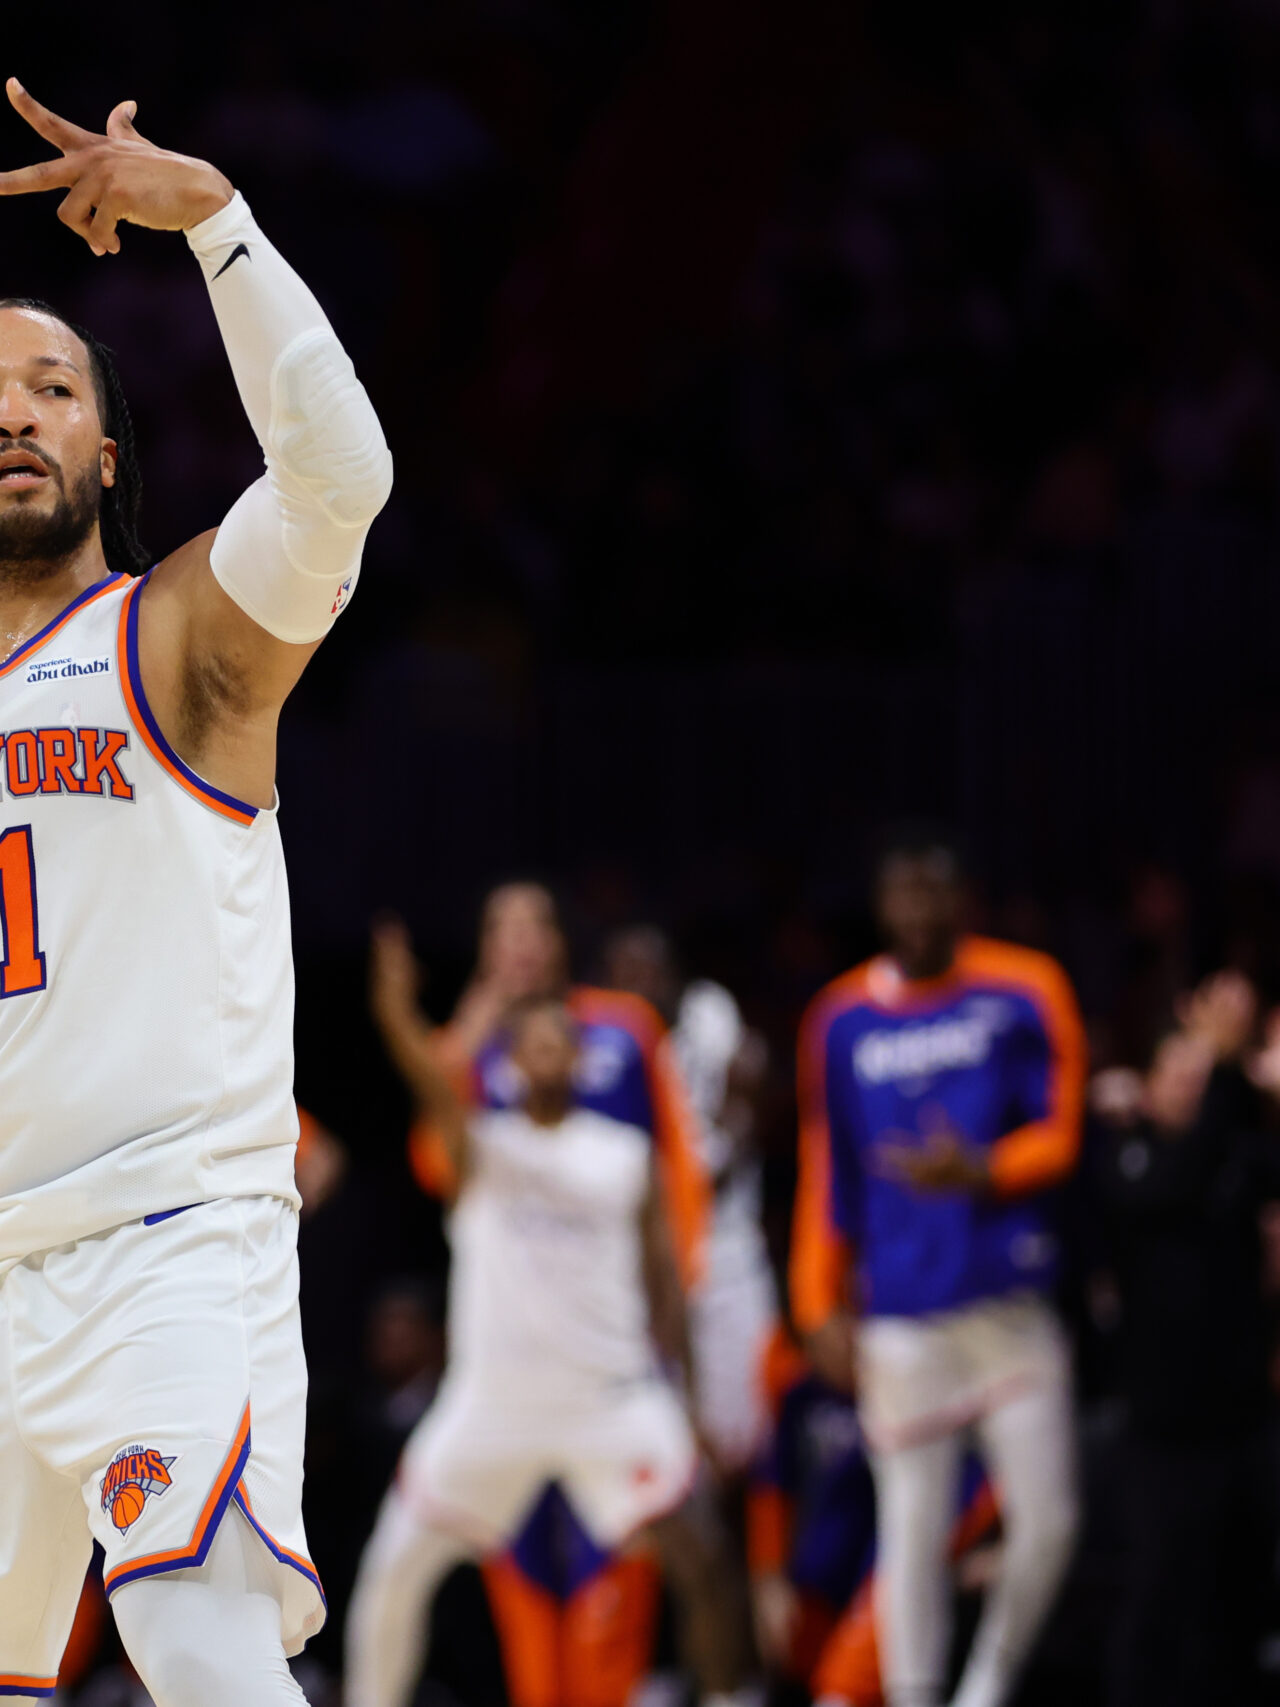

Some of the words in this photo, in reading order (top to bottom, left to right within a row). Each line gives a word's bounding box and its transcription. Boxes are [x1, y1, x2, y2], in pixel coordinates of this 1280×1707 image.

[27, 670, 58, 683] abu
[61, 658, 109, 677] dhabi
[29, 658, 72, 670] experience
[128, 1445, 144, 1454] YORK
[101, 1449, 173, 1511] KNICKS
